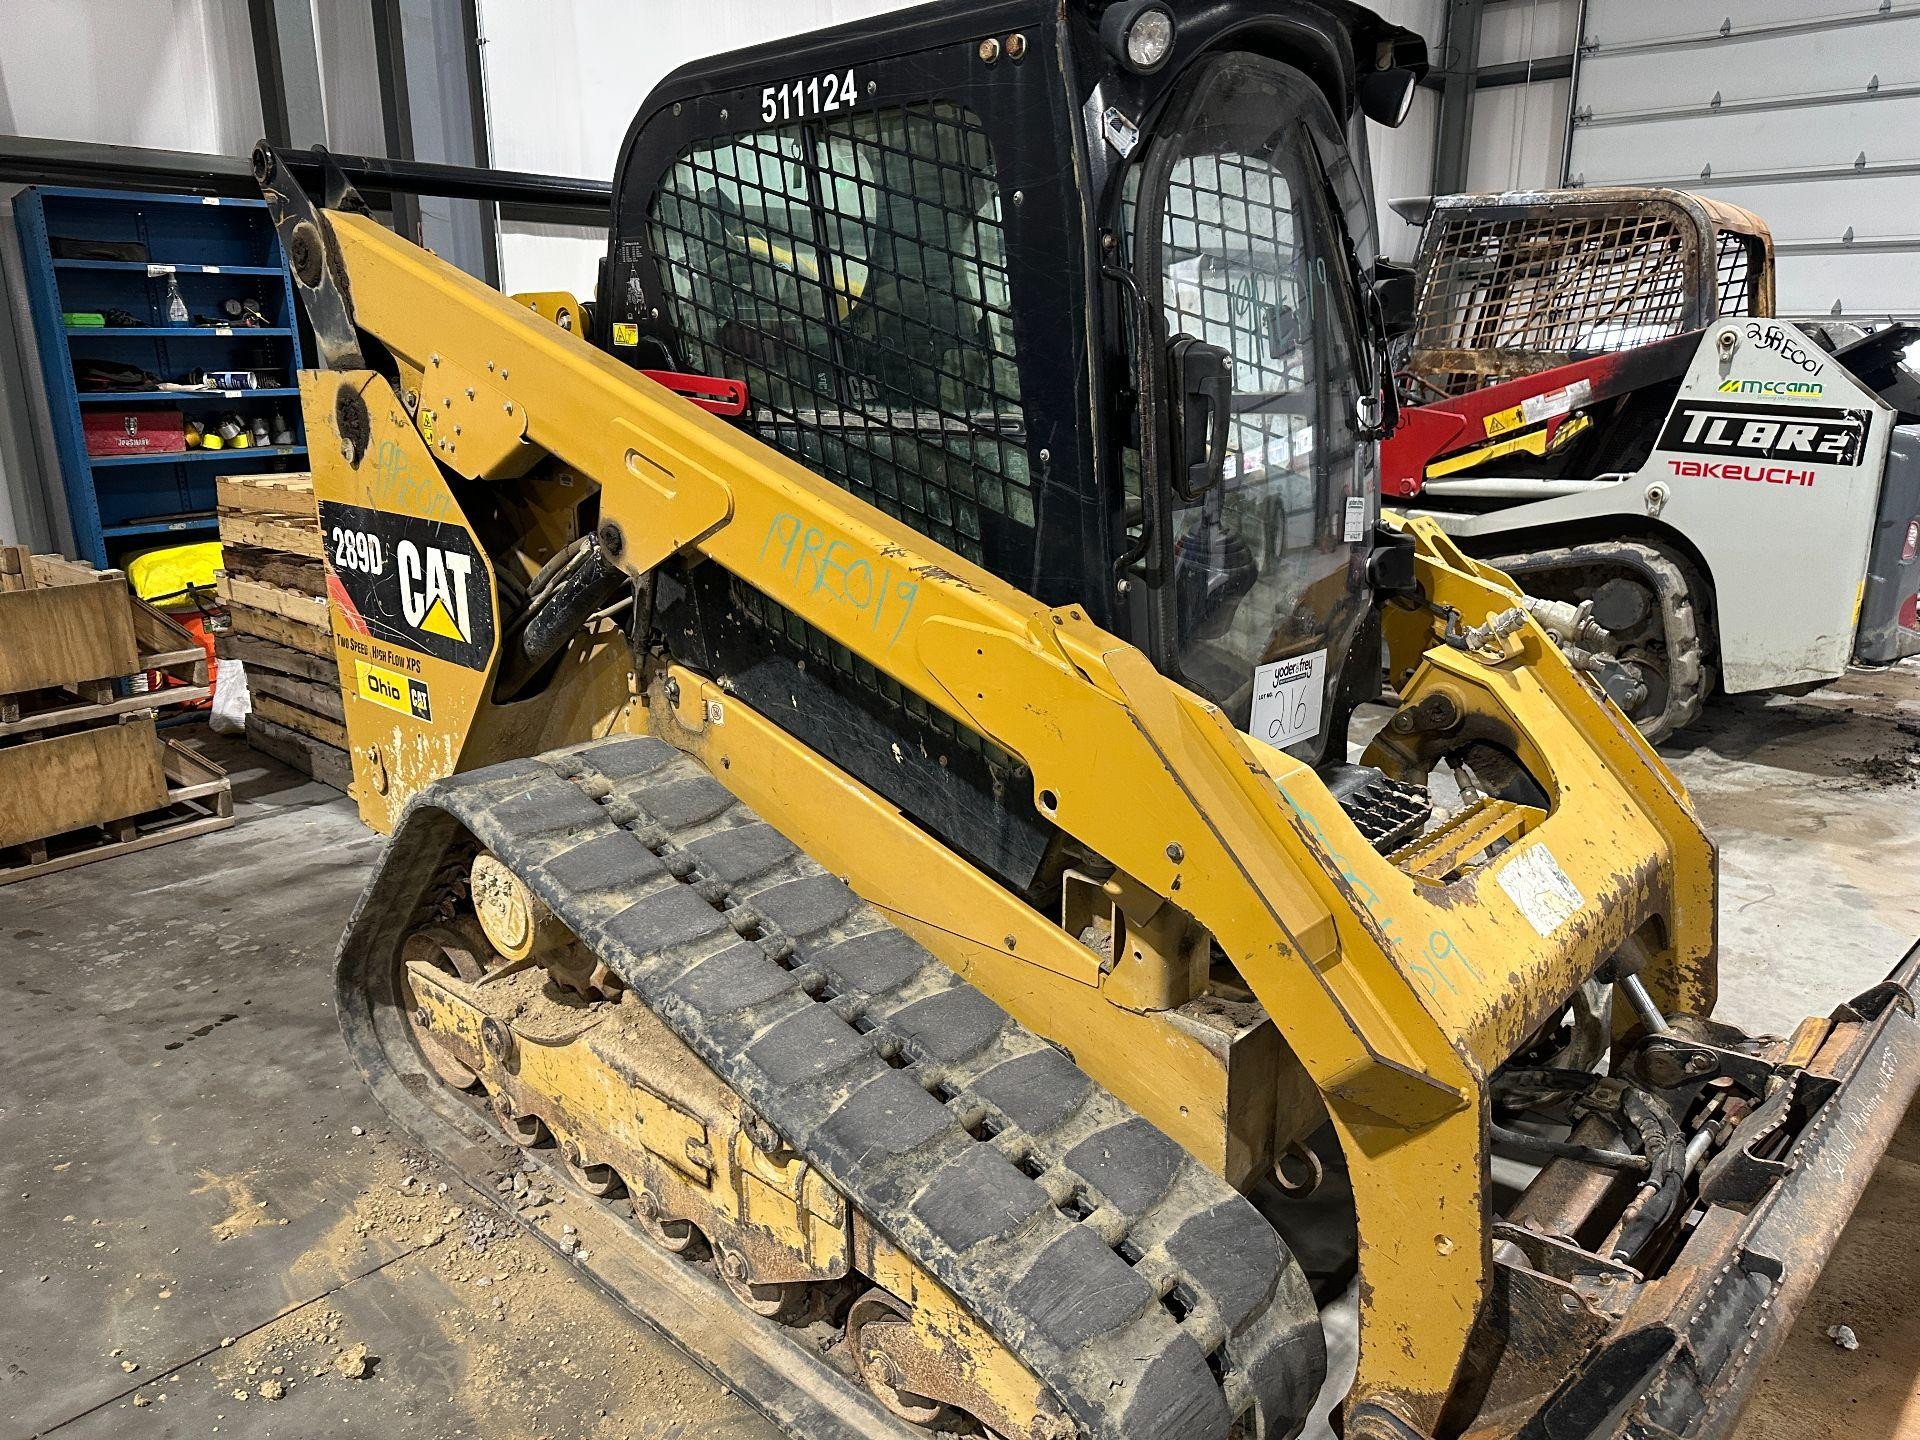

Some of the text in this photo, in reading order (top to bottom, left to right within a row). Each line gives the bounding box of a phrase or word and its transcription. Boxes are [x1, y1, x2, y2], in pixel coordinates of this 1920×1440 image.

[762, 69, 857, 123] 511124
[332, 526, 383, 576] 289D
[397, 540, 472, 644] CAT
[406, 656, 421, 674] XPS
[367, 674, 401, 701] Ohio
[411, 688, 428, 711] CAT
[1258, 693, 1267, 701] LOT
[1269, 685, 1307, 739] 216
